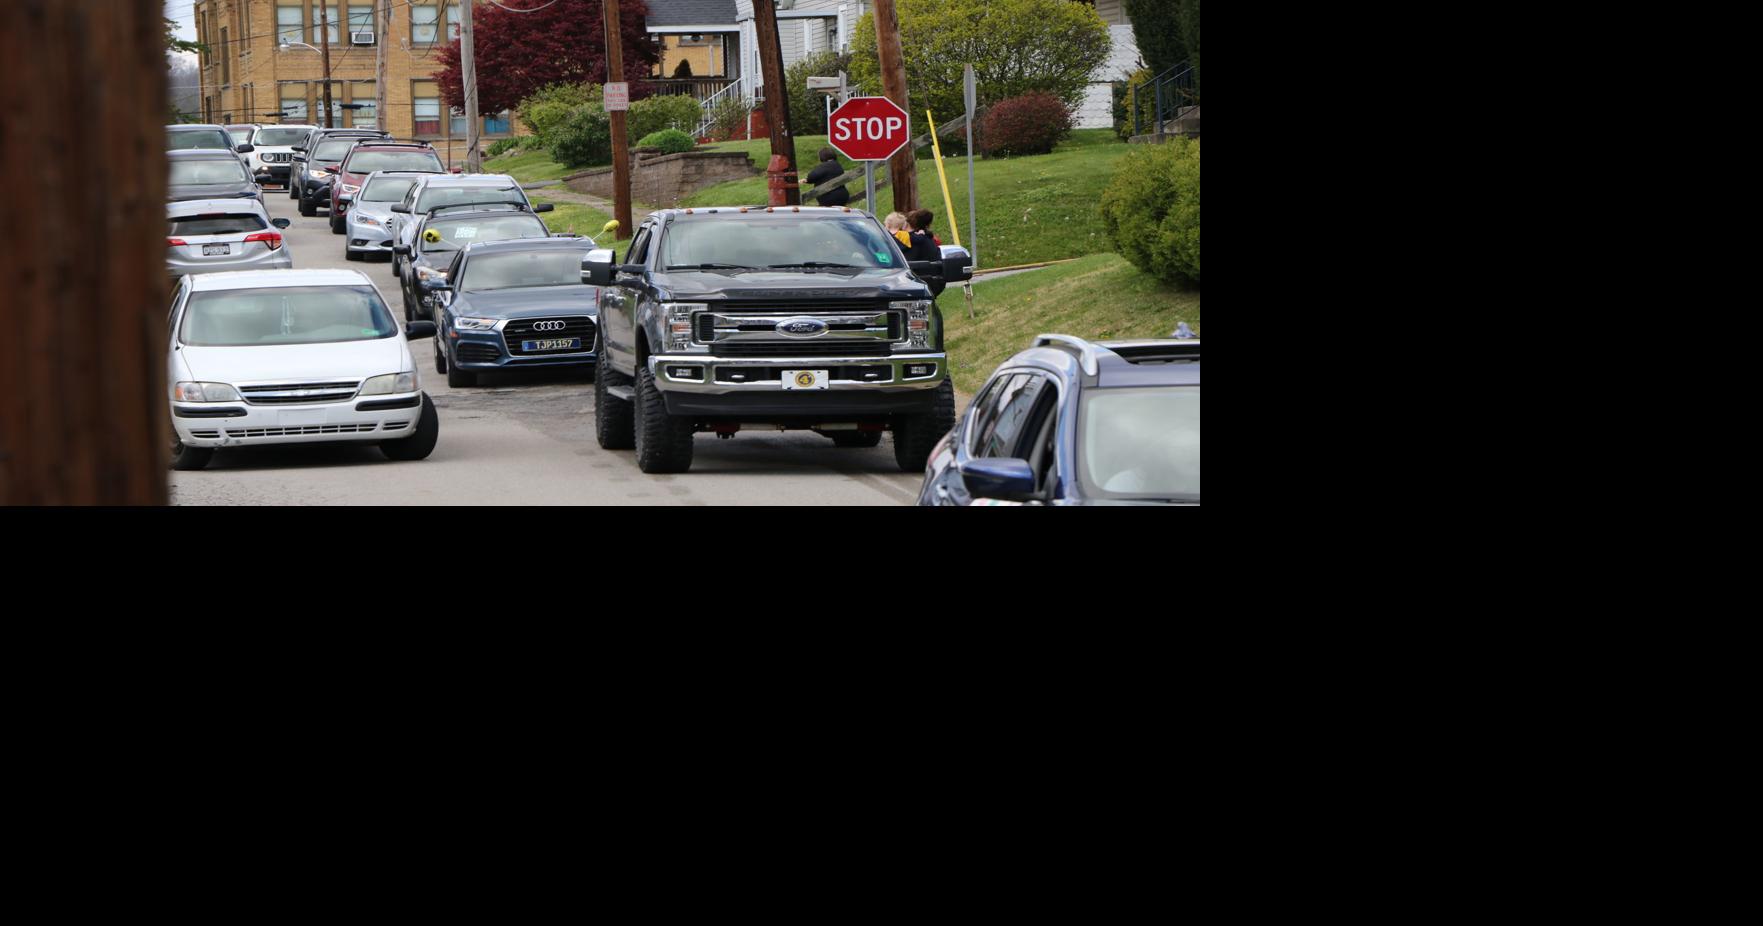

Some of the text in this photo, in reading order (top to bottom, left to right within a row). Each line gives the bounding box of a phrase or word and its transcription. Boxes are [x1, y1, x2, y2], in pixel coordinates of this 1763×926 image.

[834, 116, 902, 141] STOP
[790, 322, 815, 332] Ford
[535, 339, 573, 349] TJP1157
